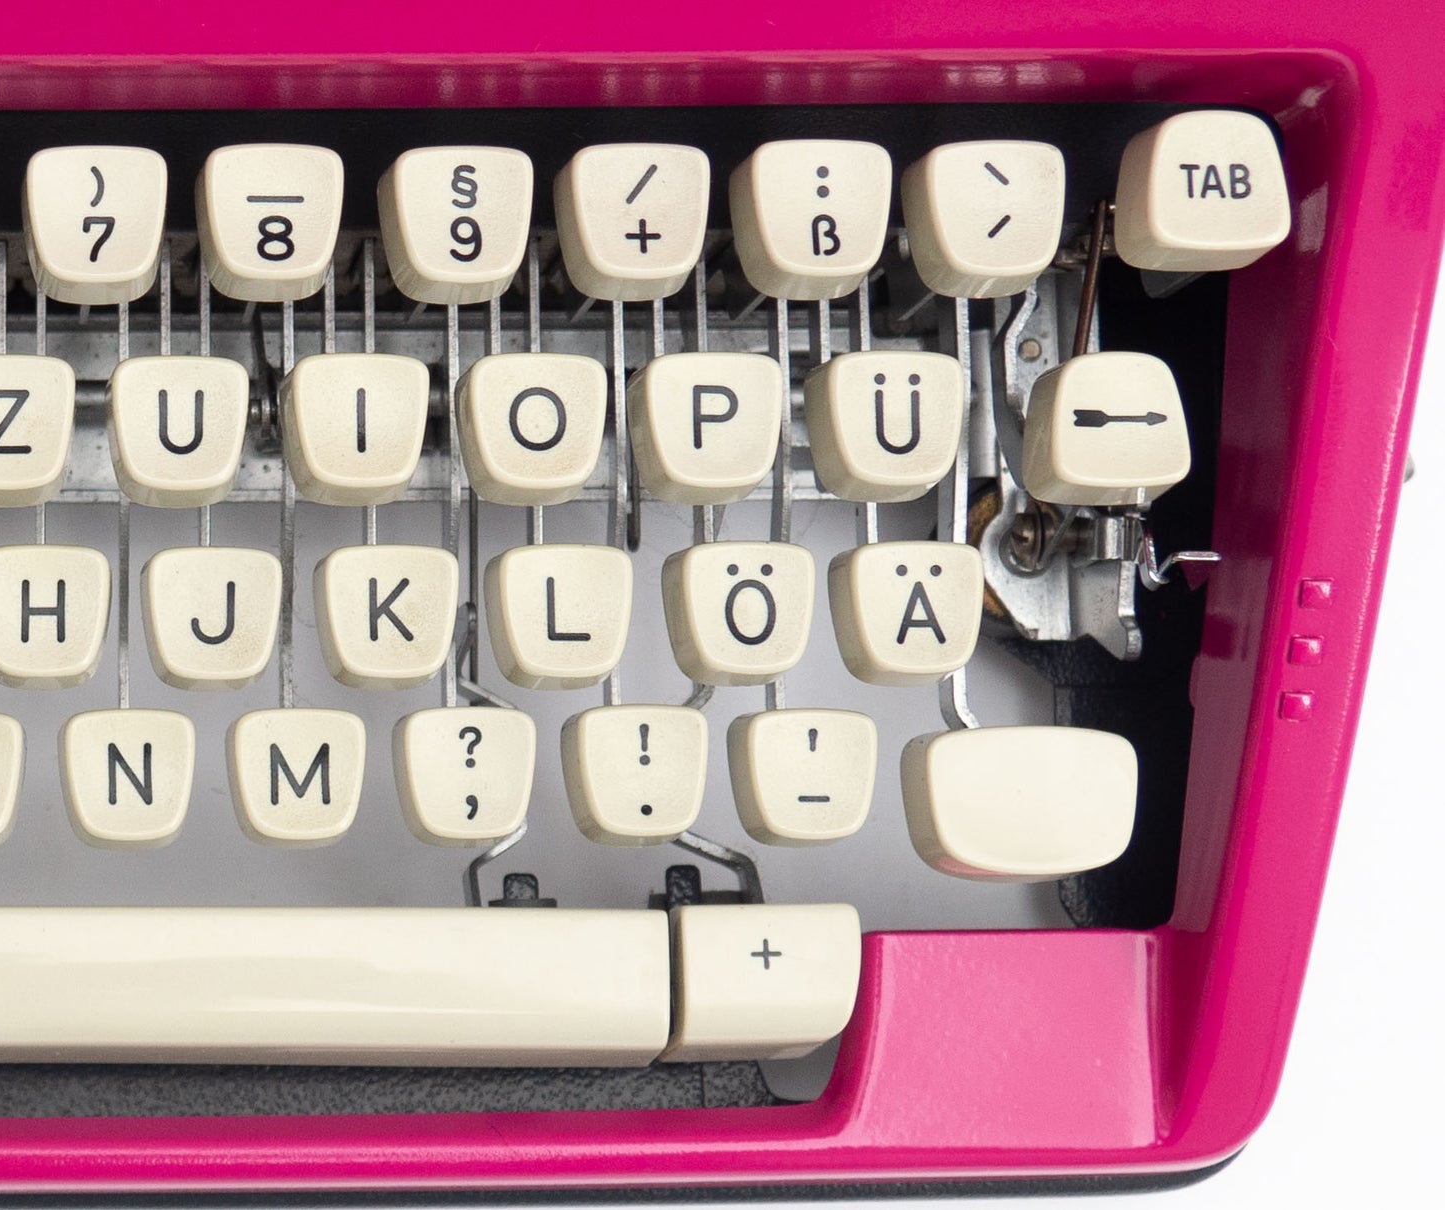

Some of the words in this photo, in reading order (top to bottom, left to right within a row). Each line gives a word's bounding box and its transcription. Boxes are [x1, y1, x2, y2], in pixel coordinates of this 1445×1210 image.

[90, 167, 105, 207] )
[452, 165, 477, 208] §
[626, 165, 657, 204] /
[816, 166, 830, 198] :
[1180, 164, 1251, 199] TAB
[83, 217, 115, 262] 7
[257, 216, 295, 261] 8
[450, 216, 482, 262] 9
[625, 219, 661, 253] +
[159, 390, 204, 454] U
[356, 388, 367, 453] I
[509, 387, 566, 451] O
[693, 385, 738, 449] P
[874, 374, 920, 455] Ü
[21, 579, 65, 643] H
[191, 581, 235, 645] J
[369, 578, 414, 641] K
[547, 577, 591, 641] L
[725, 564, 776, 645] Ö
[896, 565, 946, 644] Ä
[108, 743, 152, 805] N
[270, 743, 330, 805] M
[459, 727, 482, 768] ?
[639, 724, 651, 765] !
